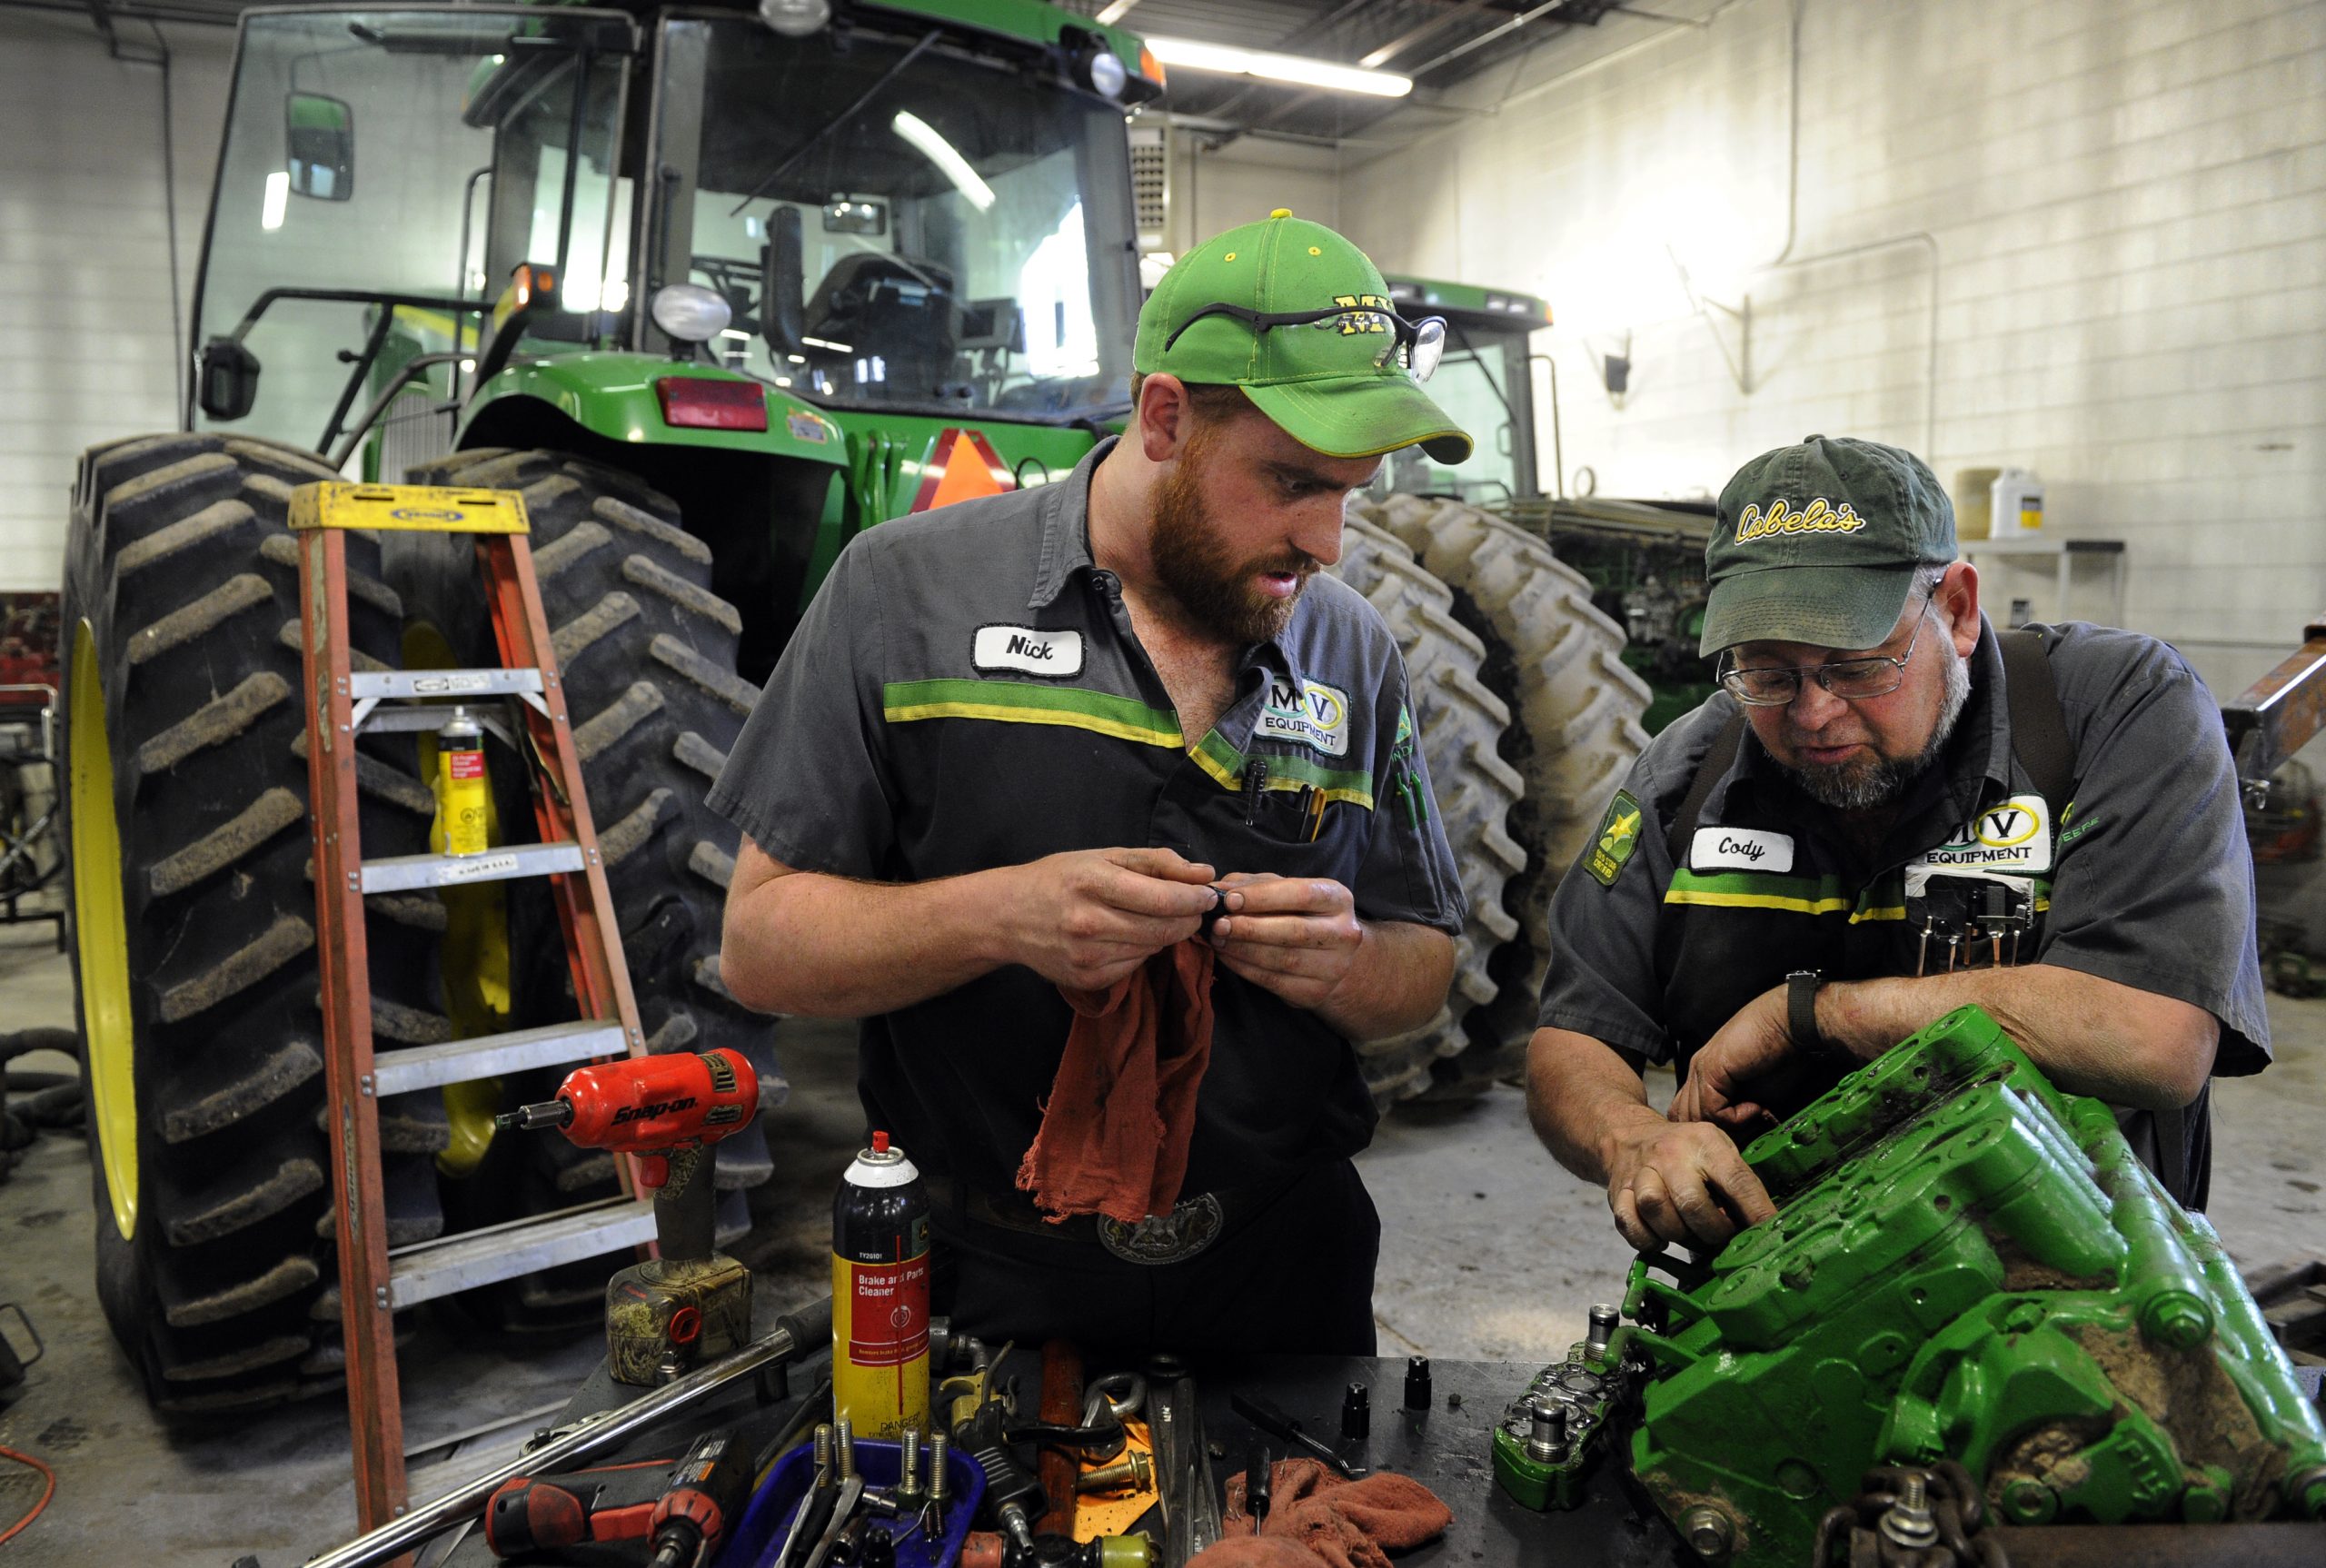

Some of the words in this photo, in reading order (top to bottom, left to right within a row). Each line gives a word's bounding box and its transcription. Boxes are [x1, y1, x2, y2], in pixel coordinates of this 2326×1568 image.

[1735, 497, 1866, 545] Cabela's
[1006, 634, 1053, 660] Nick
[1265, 717, 1337, 747] EQUIPMENT
[1719, 837, 1765, 861] Cody
[1926, 847, 2032, 864] EQUIPMENT
[859, 1275, 886, 1285] Brake
[907, 1266, 924, 1281] Parts
[859, 1285, 894, 1296] Cleaner
[880, 1413, 919, 1432] DANGER
